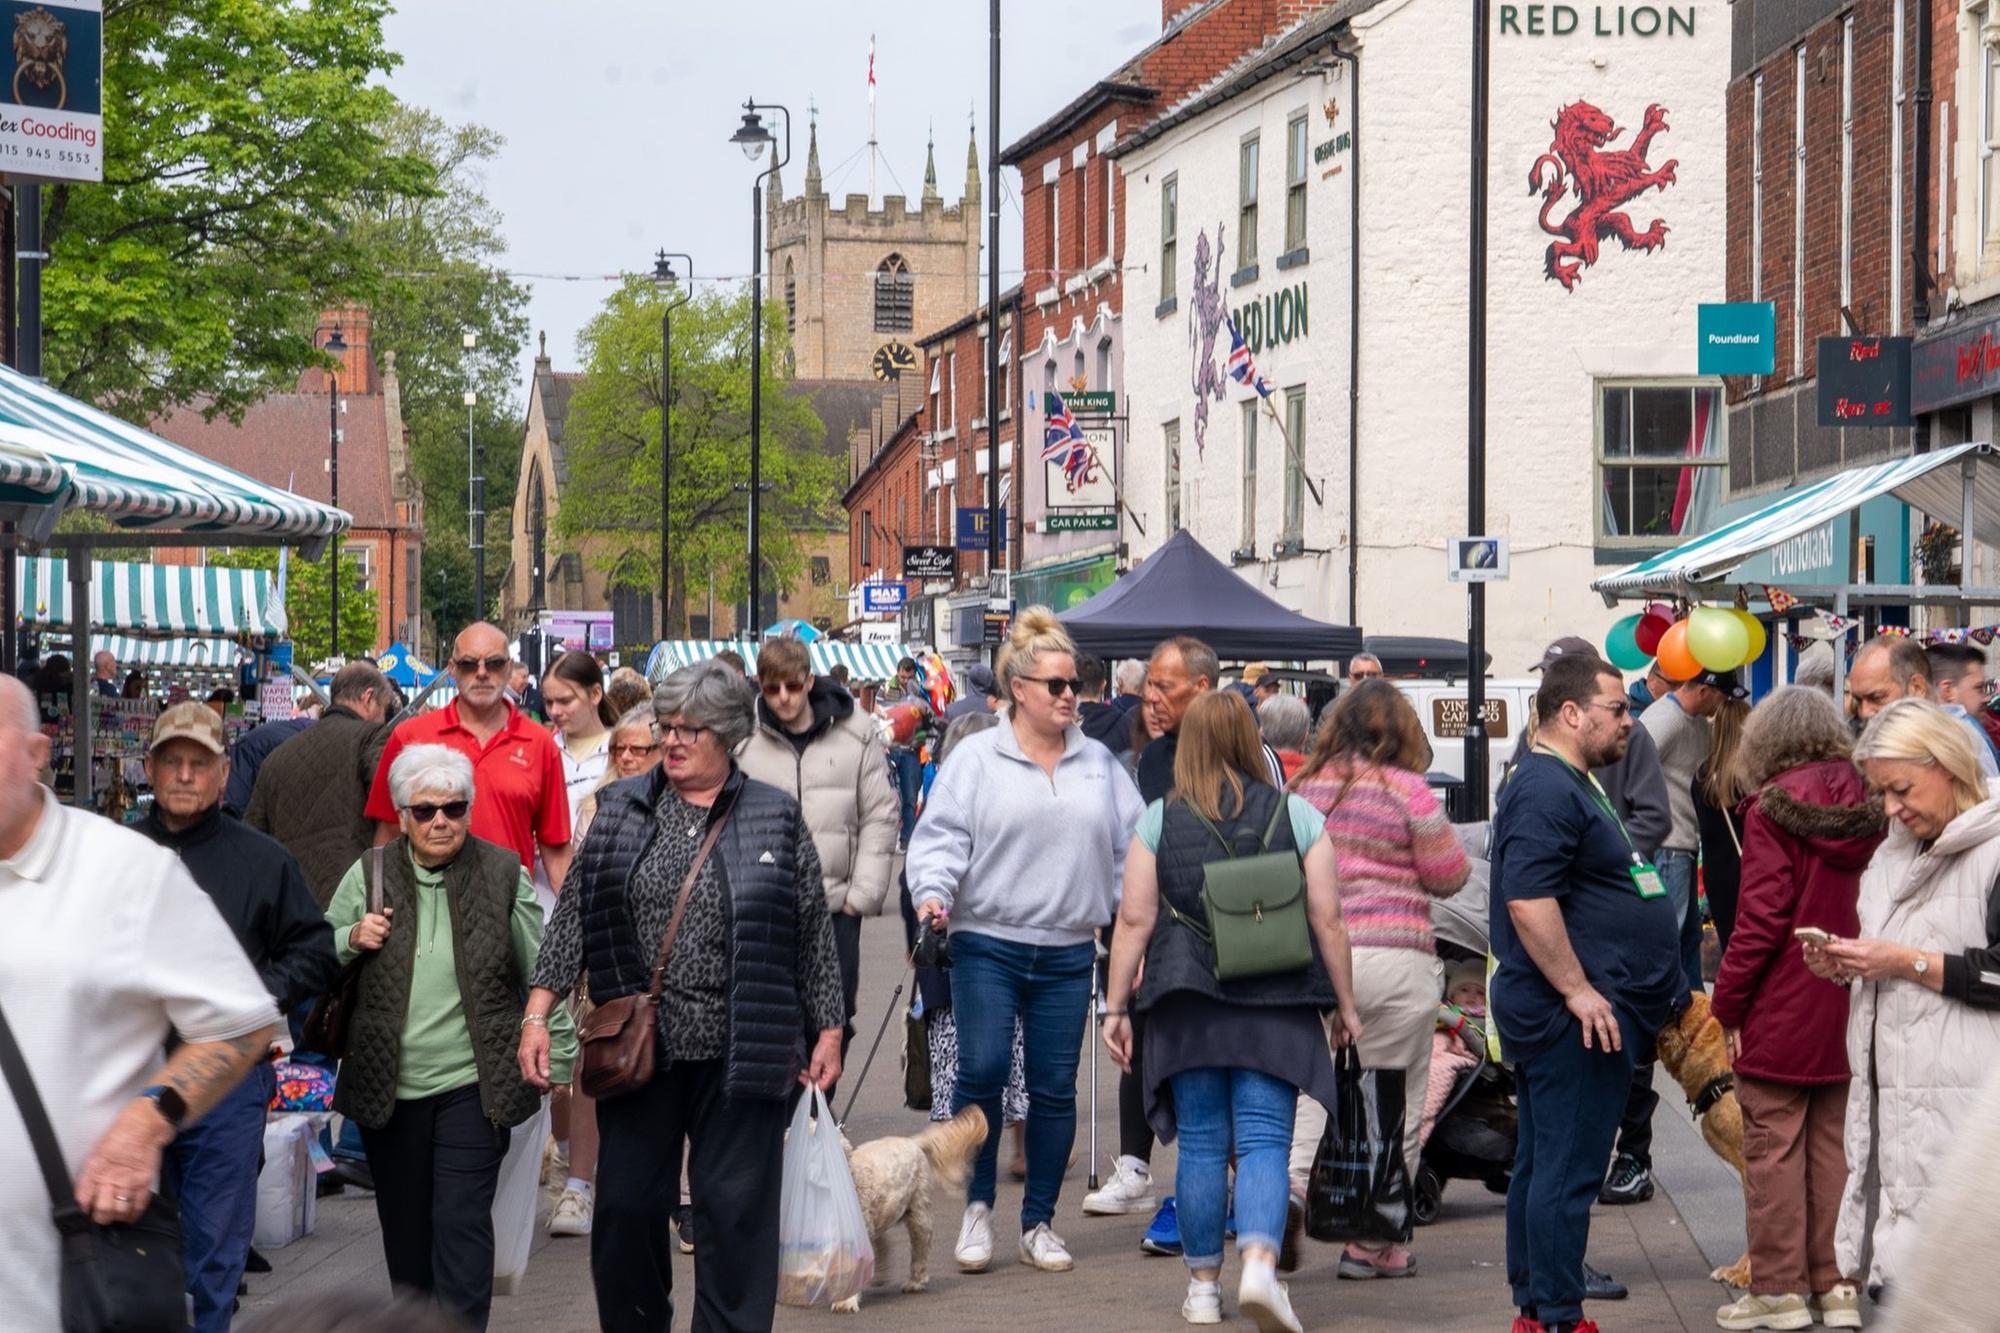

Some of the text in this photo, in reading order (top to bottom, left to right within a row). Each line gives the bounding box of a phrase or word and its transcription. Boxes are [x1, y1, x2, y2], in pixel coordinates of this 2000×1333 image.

[1500, 5, 1695, 37] RED LION
[0, 112, 97, 148] ex Gooding
[26, 146, 51, 160] 945
[59, 150, 91, 165] 5553
[1266, 281, 1308, 350] LION
[1708, 334, 1760, 344] Poundland
[1087, 398, 1109, 407] KING
[1050, 517, 1099, 529] CAR PARK
[906, 554, 932, 567] Sweet
[870, 587, 900, 600] MAX
[263, 687, 291, 695] VAPES
[262, 697, 292, 705] FROM
[1441, 712, 1468, 722] CAF
